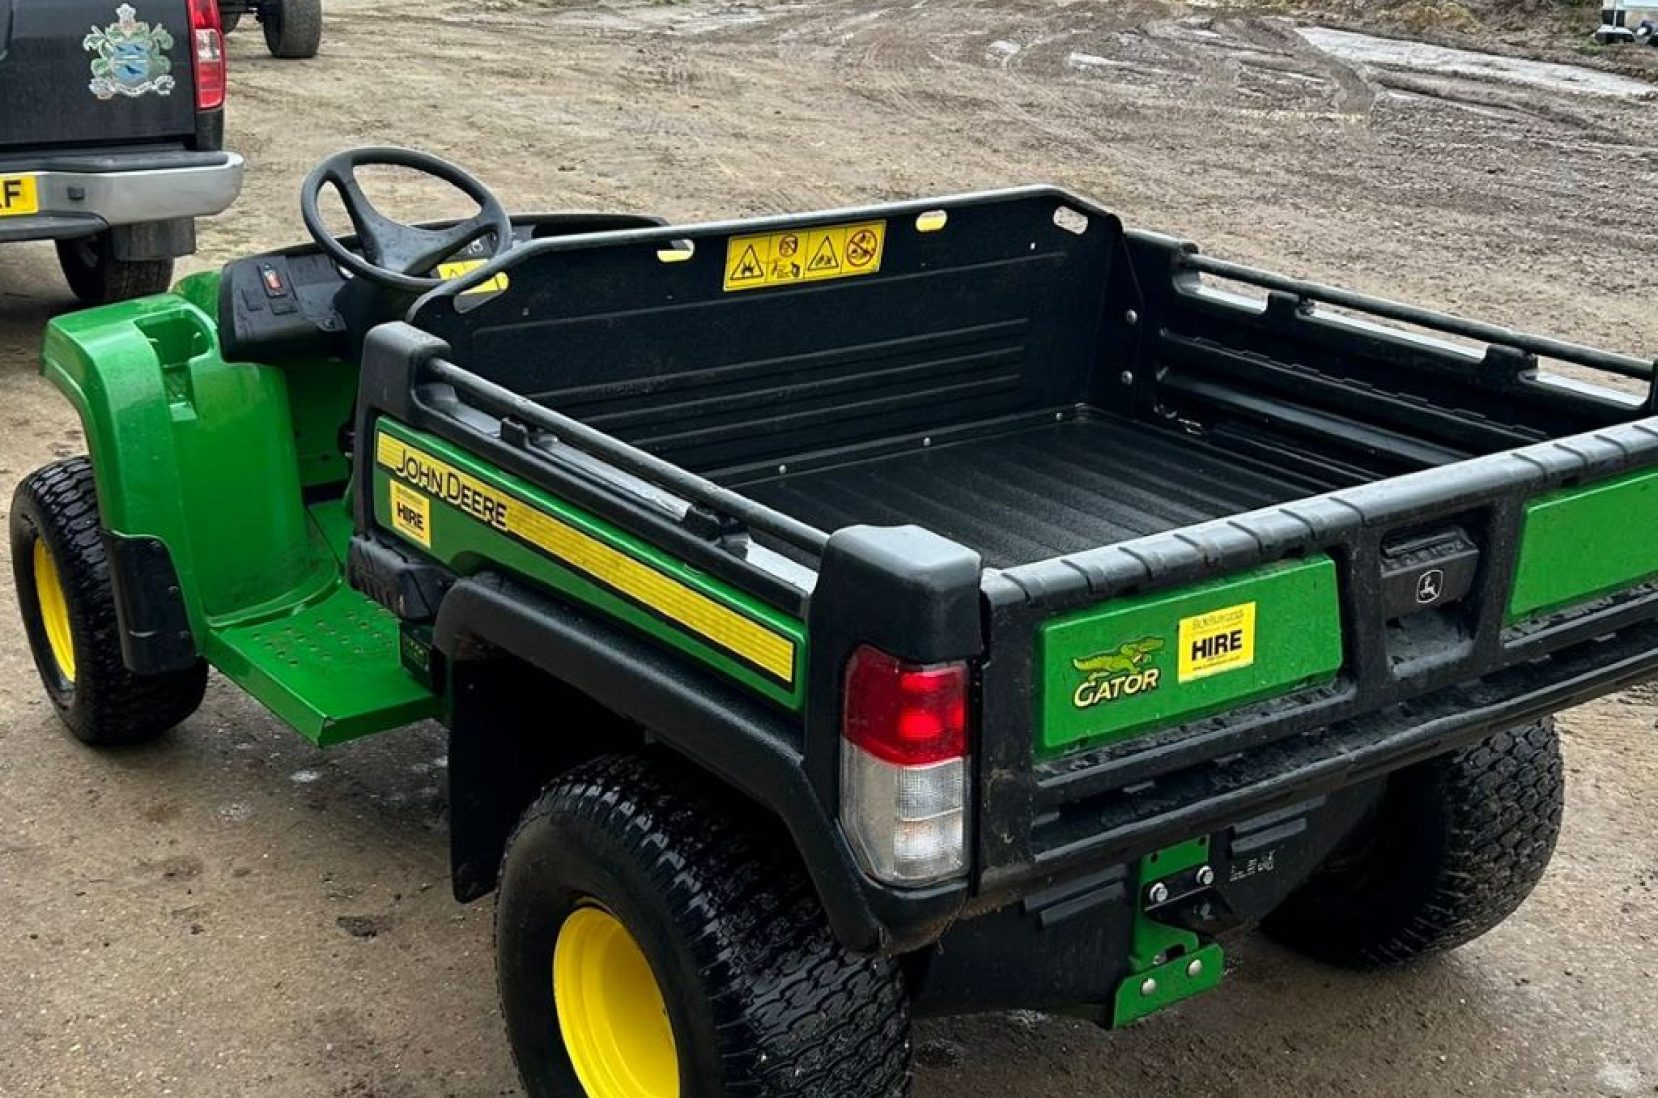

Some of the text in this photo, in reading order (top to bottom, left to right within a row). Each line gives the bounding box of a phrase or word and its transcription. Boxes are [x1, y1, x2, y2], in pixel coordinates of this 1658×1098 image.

[0, 179, 22, 209] F
[395, 449, 443, 495] JOHN
[447, 474, 508, 530] DEERE
[396, 501, 424, 531] HIRE
[1191, 629, 1243, 662] HIRE
[1073, 667, 1161, 709] GATOR
